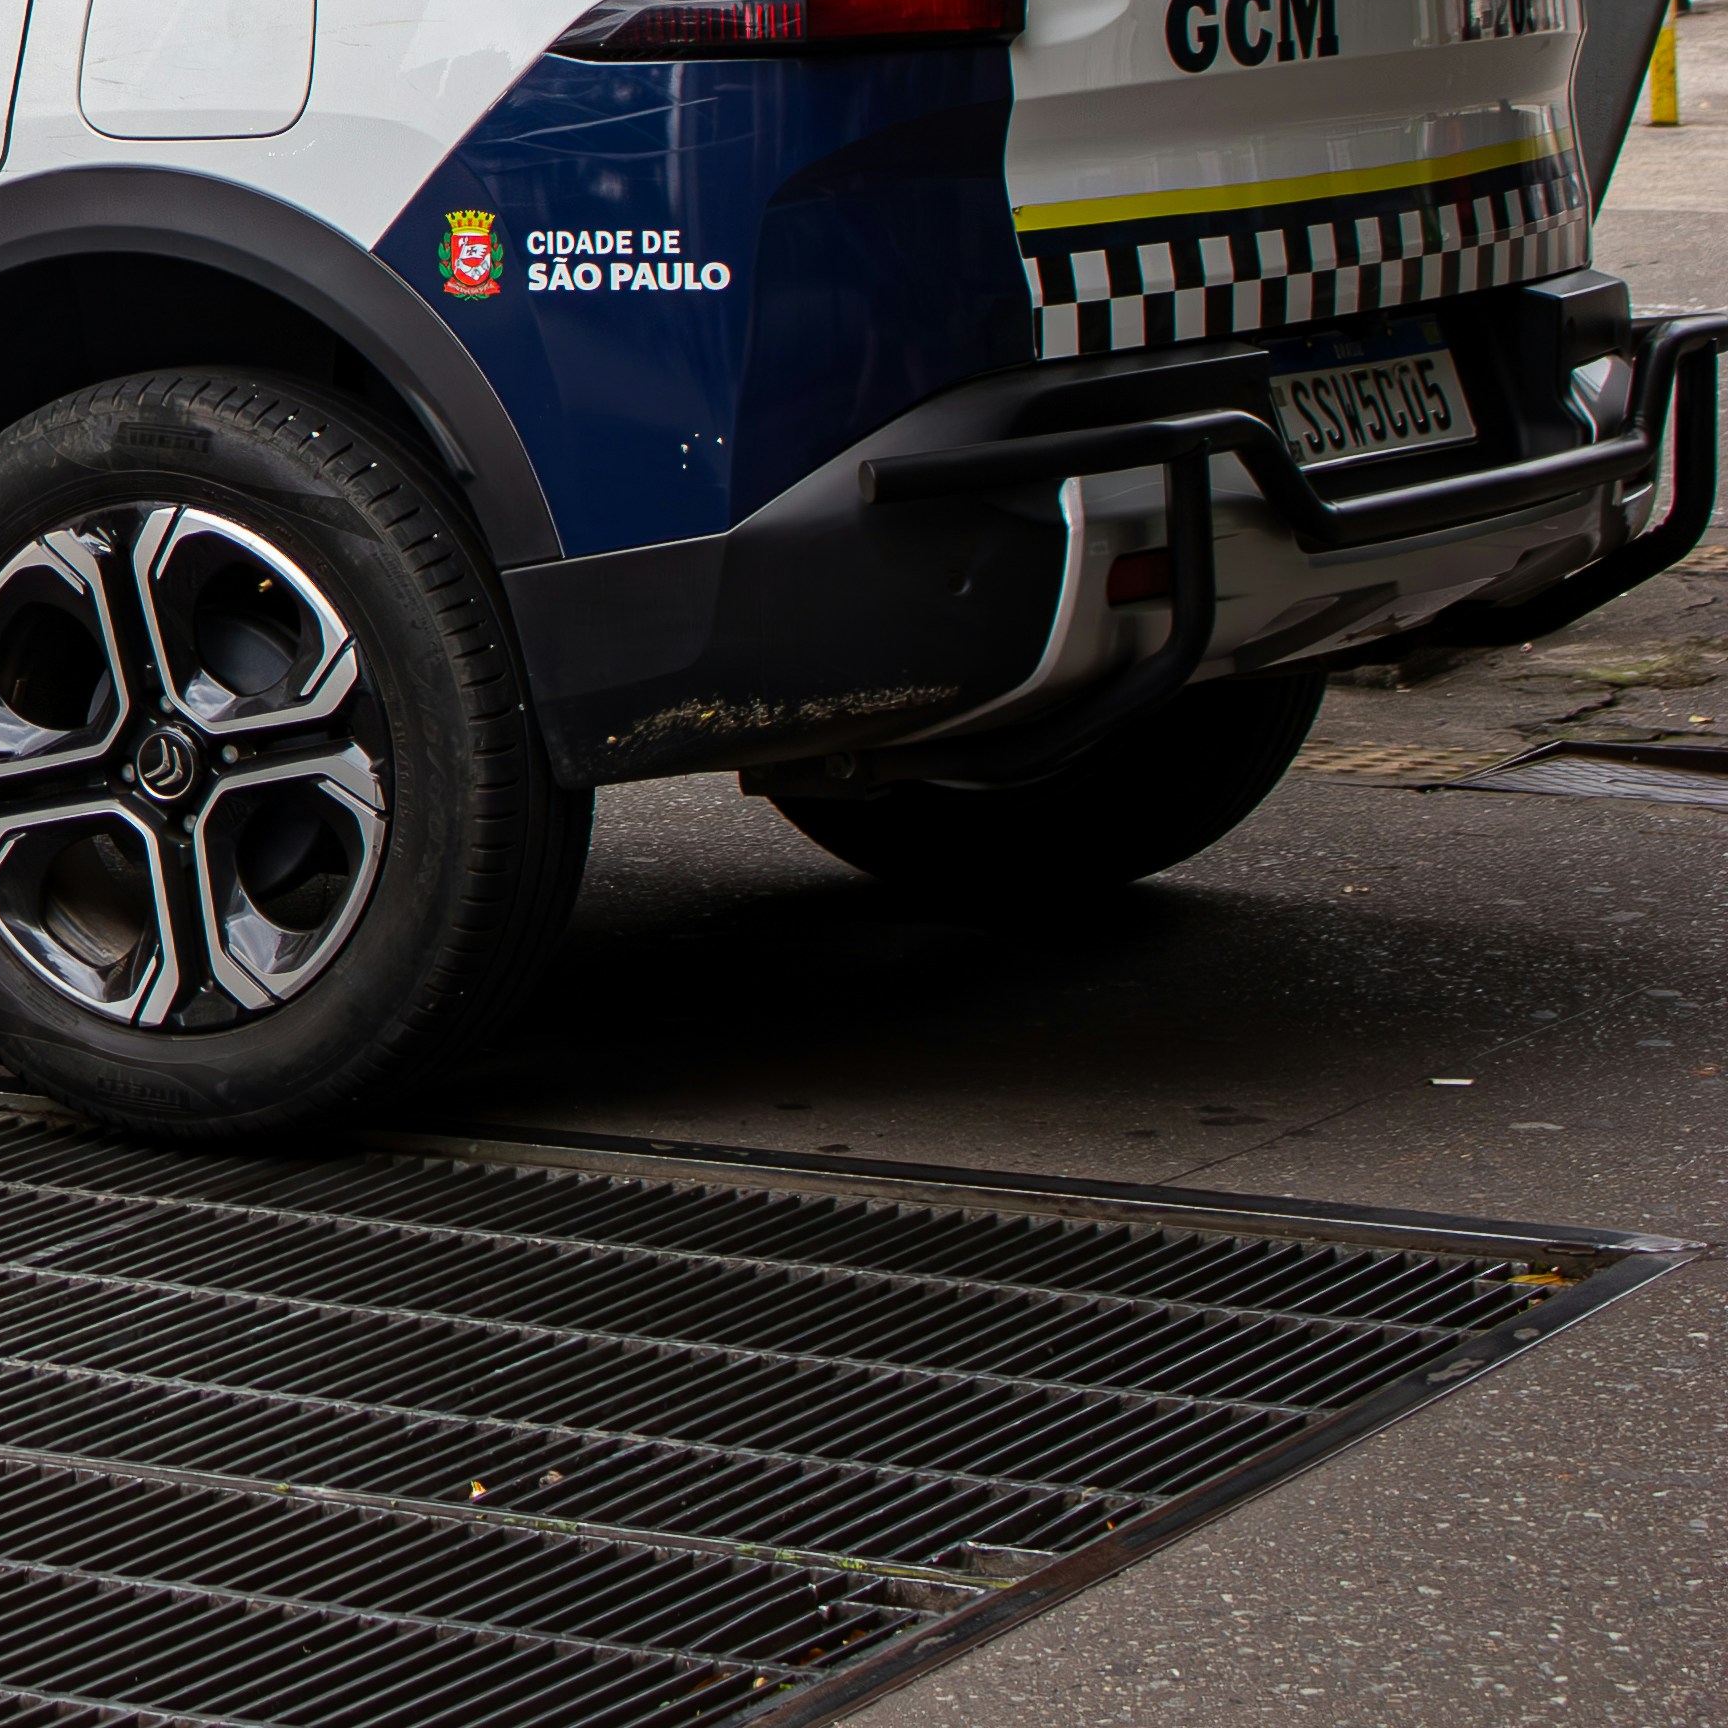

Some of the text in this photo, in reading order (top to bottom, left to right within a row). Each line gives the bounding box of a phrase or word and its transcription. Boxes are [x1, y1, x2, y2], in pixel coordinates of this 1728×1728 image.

[527, 230, 681, 255] CIDADE DE
[528, 257, 602, 291] SÃO
[610, 261, 731, 291] PAULO
